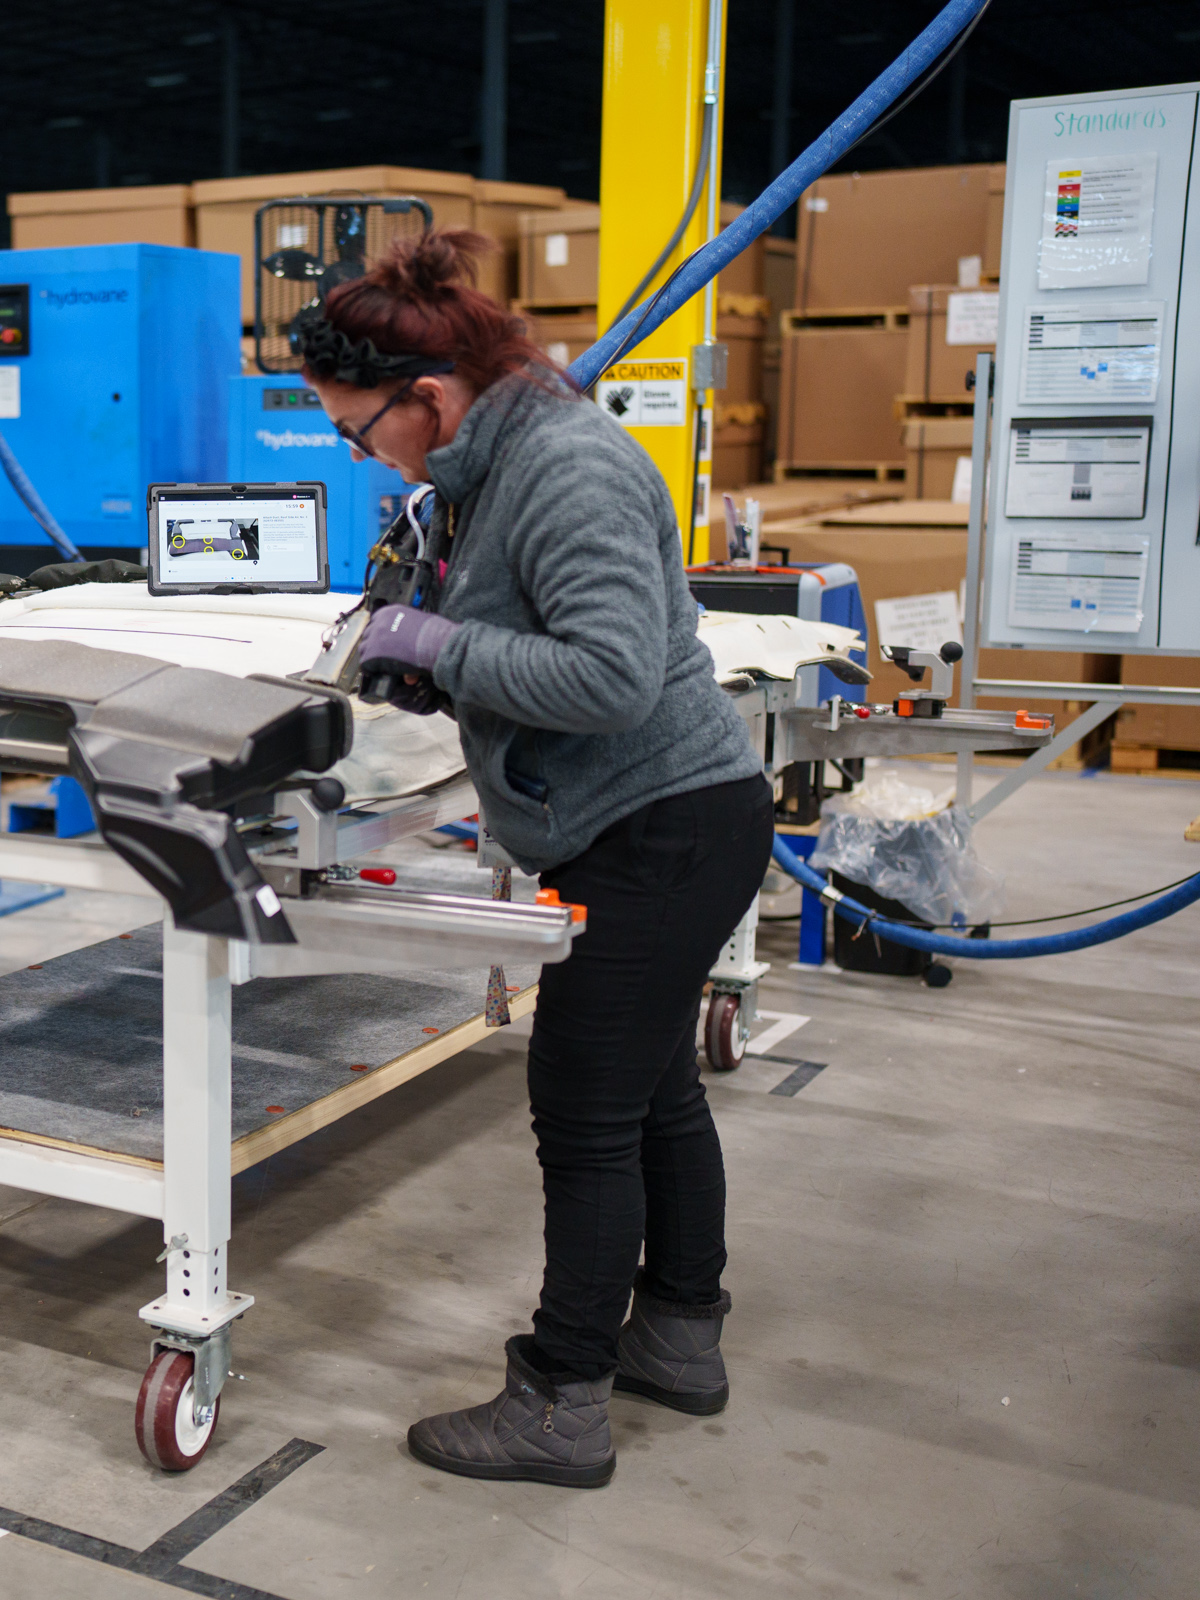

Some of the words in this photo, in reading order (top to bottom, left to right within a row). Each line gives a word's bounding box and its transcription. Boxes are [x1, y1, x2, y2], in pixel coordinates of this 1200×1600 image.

[1054, 108, 1167, 137] Standards
[47, 287, 128, 309] hydrovane
[618, 364, 681, 379] CAUTION
[263, 429, 339, 451] hydrovane
